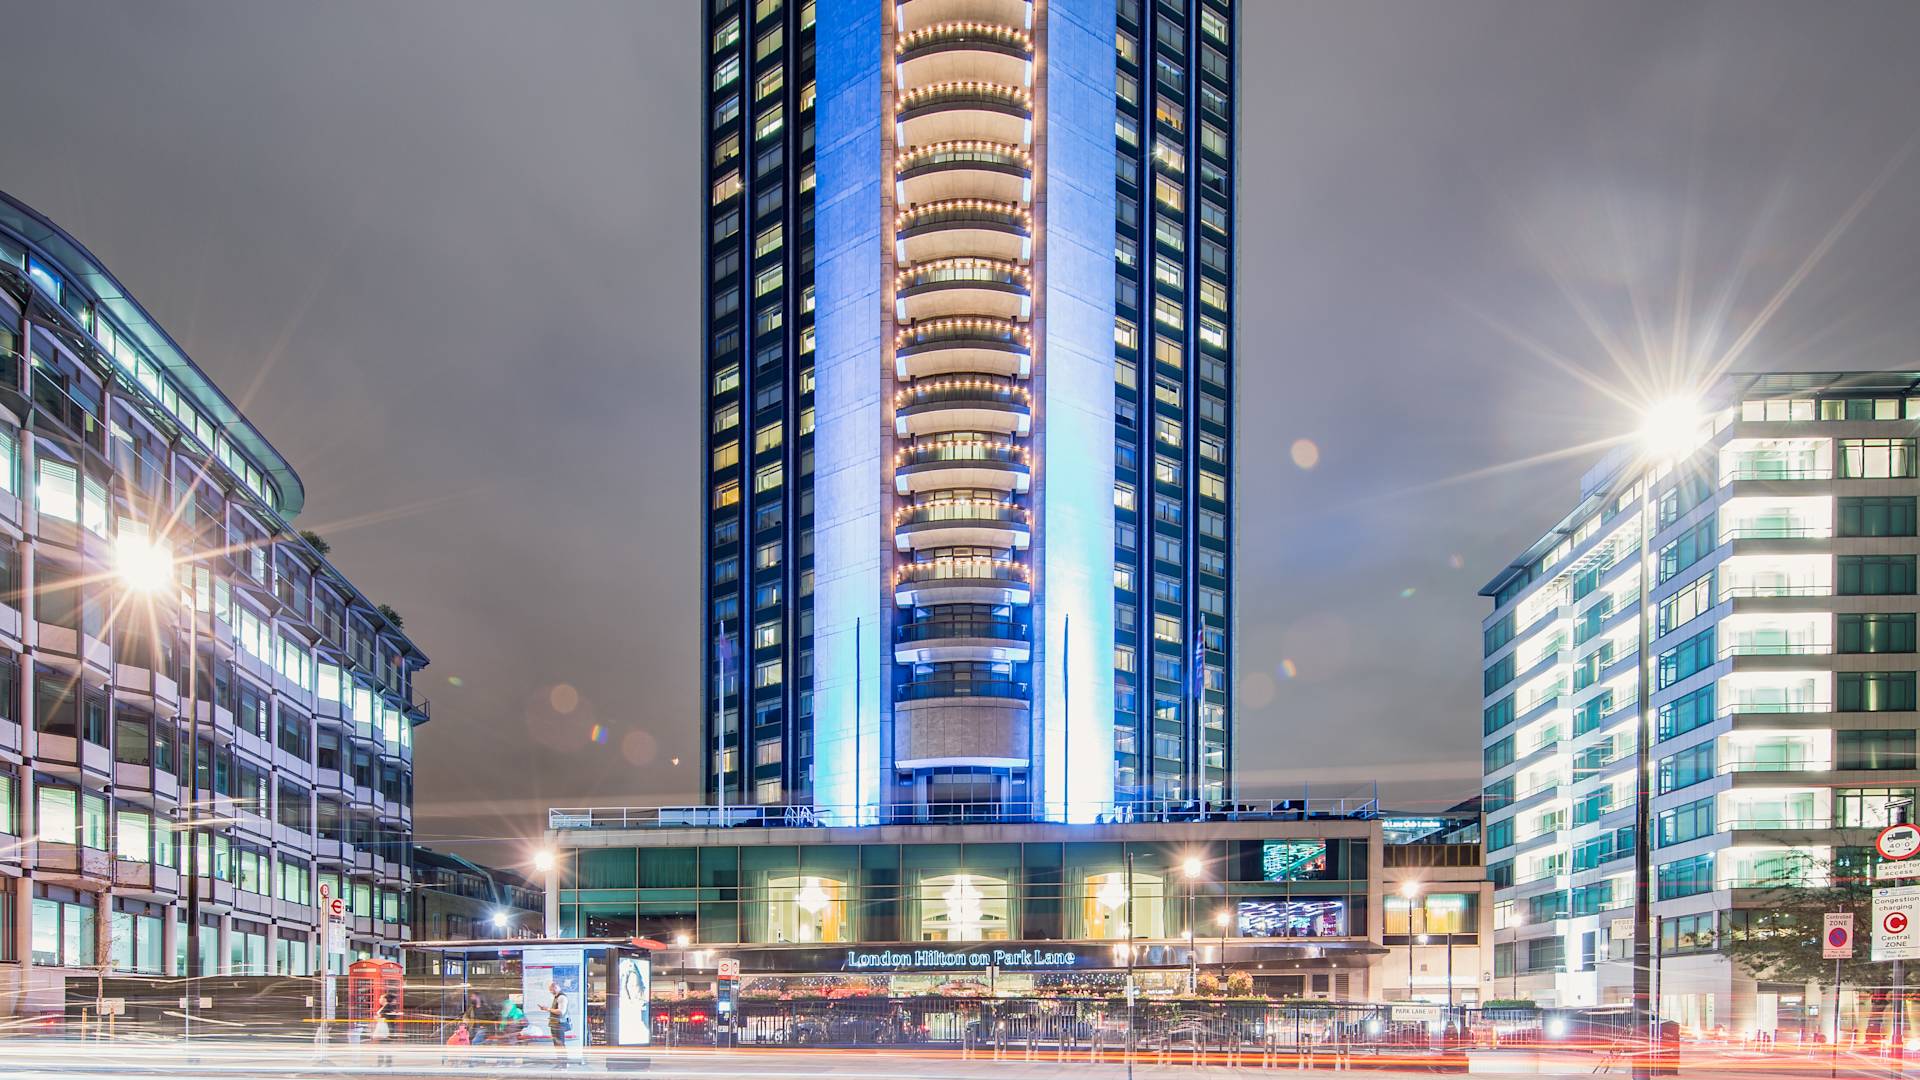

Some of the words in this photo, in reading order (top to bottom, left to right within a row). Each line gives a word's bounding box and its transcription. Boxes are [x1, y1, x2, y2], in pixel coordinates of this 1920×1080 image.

[1874, 896, 1920, 905] Congestion
[1879, 904, 1913, 912] charging
[848, 950, 912, 967] London
[914, 950, 966, 966] Hilton
[968, 953, 991, 966] on
[993, 949, 1032, 965] Park
[1034, 950, 1076, 965] Lane
